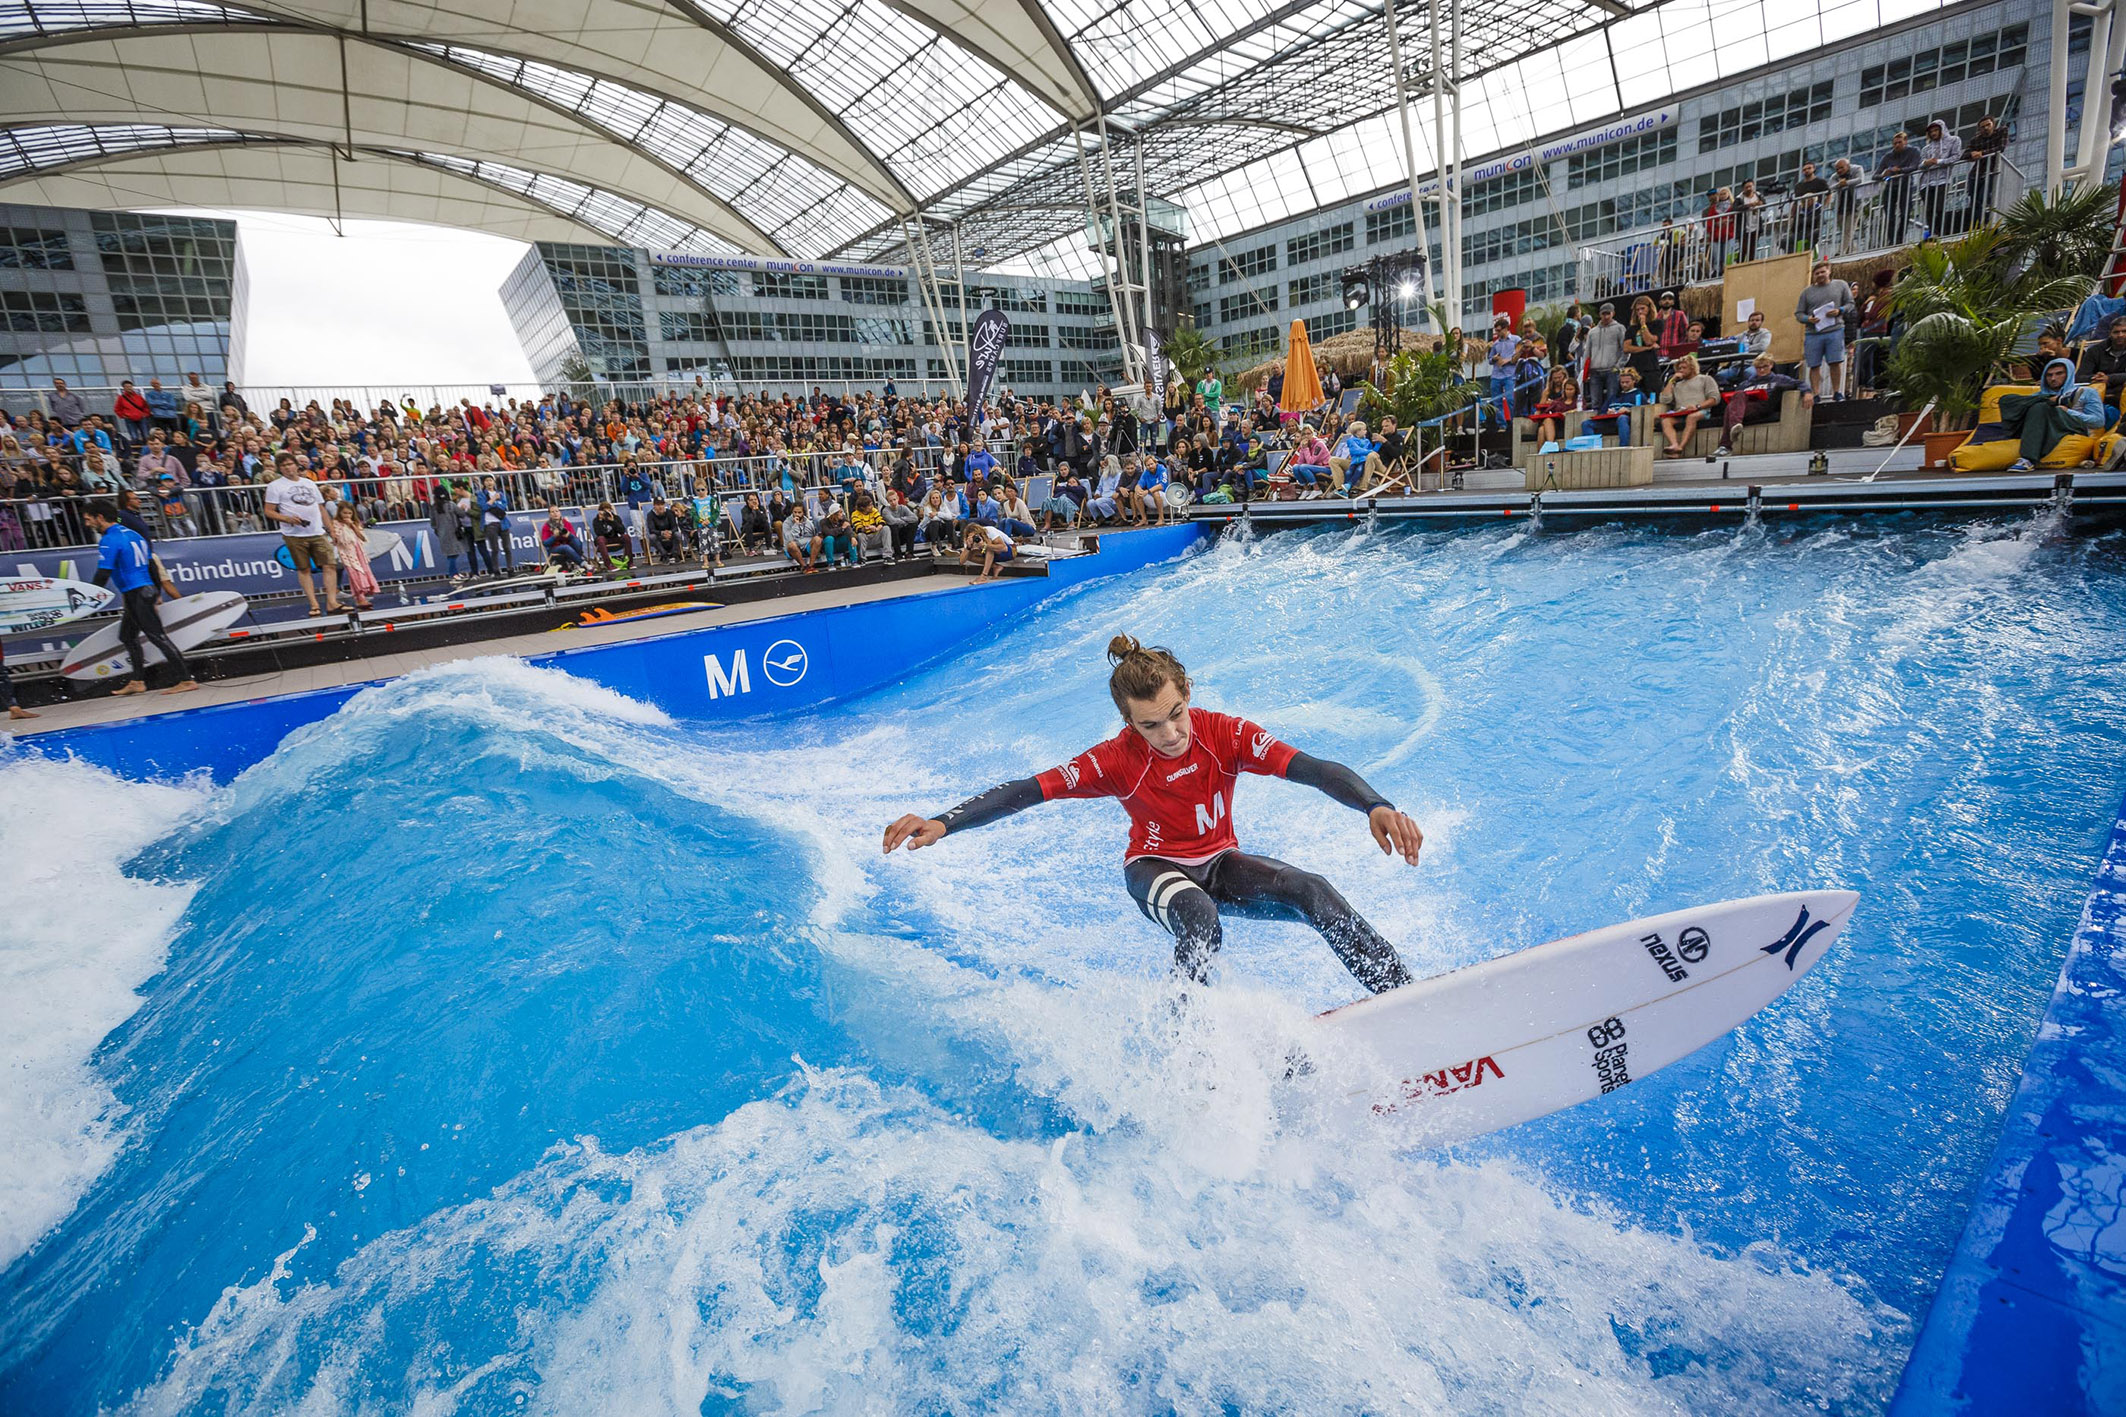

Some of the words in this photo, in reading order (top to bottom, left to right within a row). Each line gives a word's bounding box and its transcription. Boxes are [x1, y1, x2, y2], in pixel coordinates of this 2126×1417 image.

[1377, 186, 1430, 209] conferece
[1542, 117, 1655, 160] www.municon.de
[666, 253, 724, 267] conference
[726, 257, 758, 269] center
[821, 265, 896, 278] www.municon.de
[6, 580, 45, 592] VANS
[166, 558, 283, 583] rbindung
[703, 648, 751, 700] M
[1166, 762, 1199, 782] QUIKSILVER
[1195, 790, 1226, 836] M
[1591, 1048, 1616, 1096] Sports
